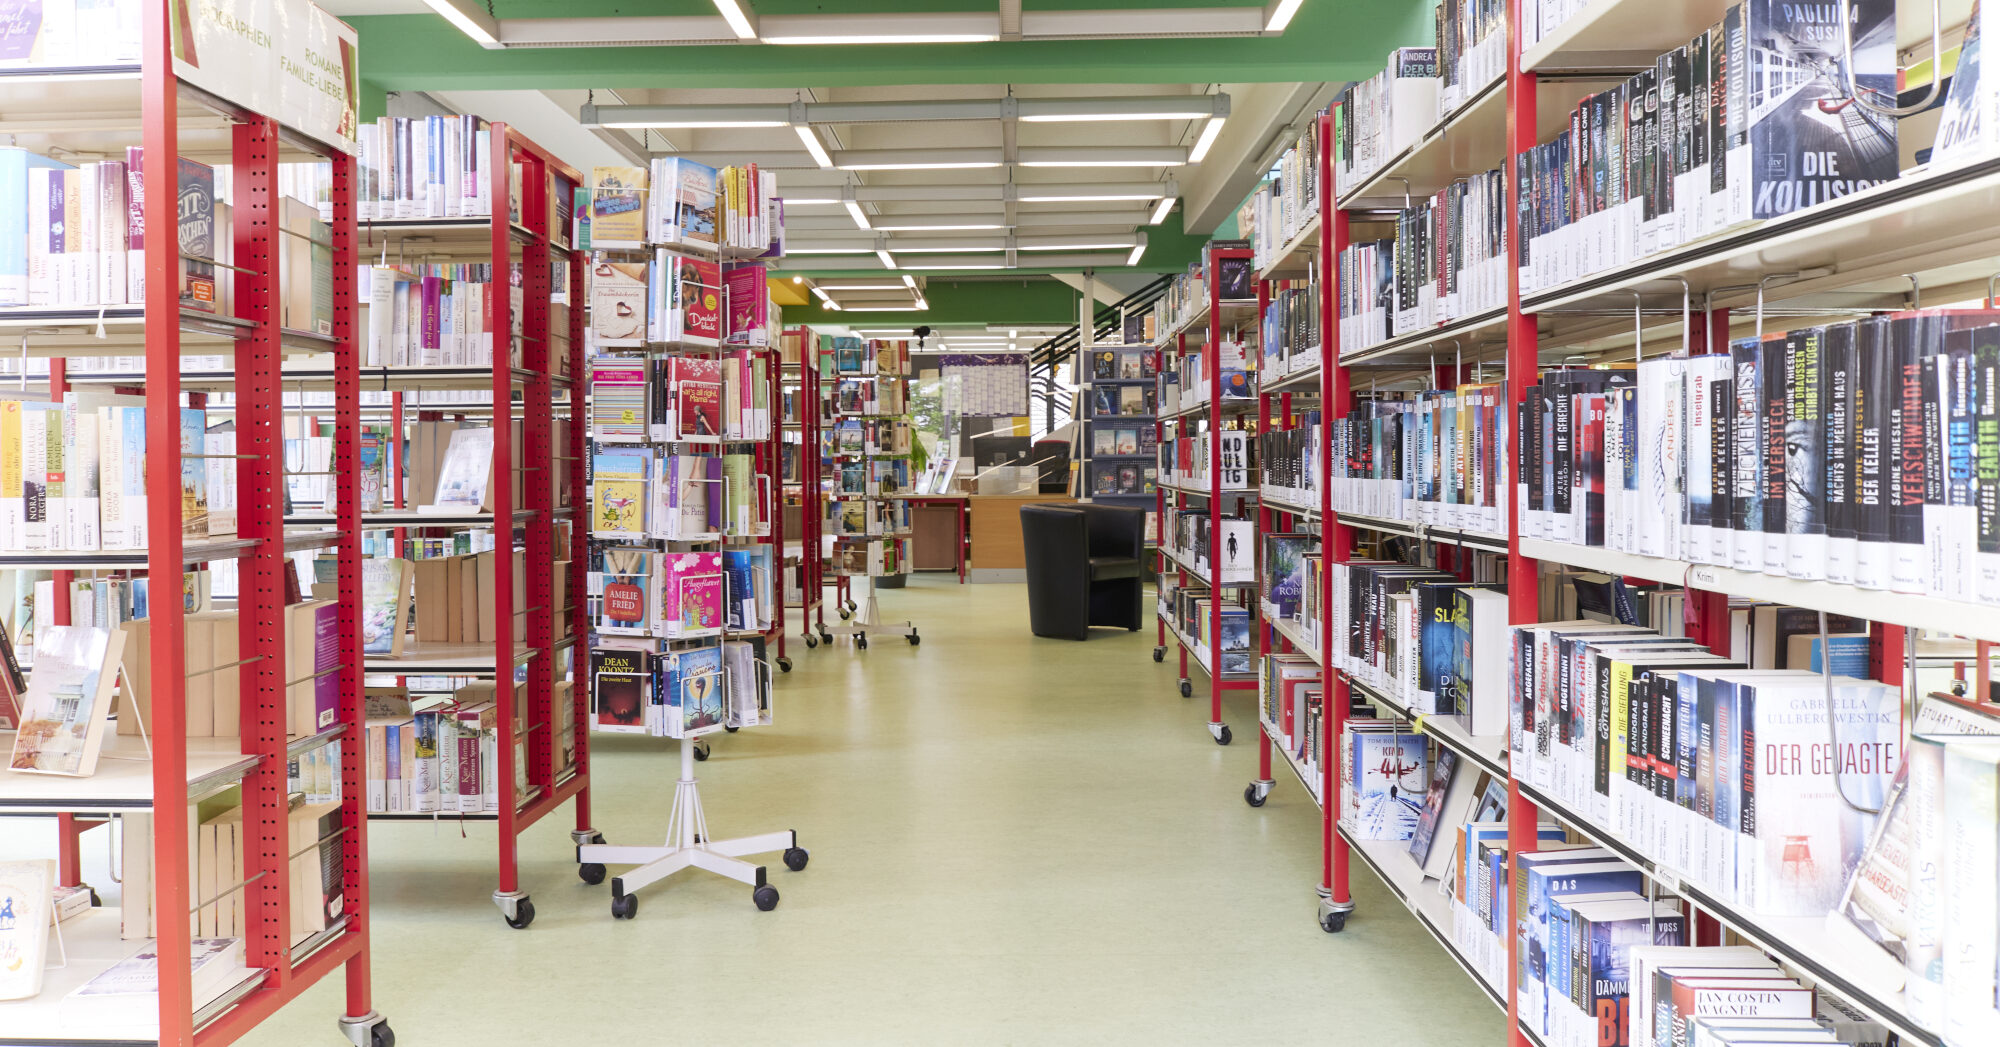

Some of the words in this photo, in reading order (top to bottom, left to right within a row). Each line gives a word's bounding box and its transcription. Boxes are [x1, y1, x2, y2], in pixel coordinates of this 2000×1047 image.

[200, 5, 271, 49] OGRAPHIEN
[1782, 3, 1859, 24] PAULIIA
[1806, 26, 1839, 41] SUSI
[305, 48, 342, 81] ROMANE
[1404, 52, 1433, 61] ANDREA
[1404, 65, 1424, 73] DER
[1731, 28, 1744, 98] KOLLISION
[281, 56, 343, 101] FAMILIE-LIEBE
[1711, 81, 1720, 106] DAS
[1731, 100, 1743, 124] DIE
[1802, 151, 1840, 177] DIE
[1595, 170, 1604, 192] Die
[1753, 179, 1889, 216] KOLLISI
[1787, 342, 1795, 384] THIESLER
[1806, 335, 1818, 366] VOGEL
[1795, 350, 1805, 399] DRAUSSEN
[1806, 369, 1818, 384] EIN
[1834, 370, 1846, 398] HAUS
[1557, 393, 1568, 433] GERECHTE
[1694, 376, 1704, 427] Inselgrab
[1787, 387, 1795, 421] SABINE
[1795, 401, 1805, 420] UND
[1806, 387, 1818, 420] STIRBT
[1533, 393, 1541, 465] KASTANIENMANN
[1738, 362, 1757, 497] ZECKENBISS
[1770, 397, 1784, 474] VERSTECK
[1834, 402, 1845, 443] MEINEM
[1855, 389, 1863, 449] THIESLER
[1891, 409, 1901, 460] THIESLER
[1902, 363, 1924, 506] VERSCHWUNDEN
[1557, 436, 1568, 452] DIE
[1717, 417, 1726, 463] KELLER
[1834, 447, 1845, 459] IN
[1863, 427, 1879, 474] KELLER
[1949, 422, 1969, 479] EARTH
[1978, 420, 1998, 479] EARTH
[1717, 470, 1726, 494] DER
[1771, 482, 1784, 499] IM
[1834, 462, 1845, 503] NACHTS
[1855, 457, 1863, 505] SABINE
[1863, 479, 1879, 505] DER
[1891, 466, 1901, 506] SABINE
[28, 495, 37, 519] NORA
[1696, 570, 1714, 583] Krimi
[610, 590, 638, 601] AMELIE
[612, 600, 635, 610] FRIED
[1378, 583, 1386, 630] Verstummt
[604, 657, 629, 667] DEAN
[1524, 643, 1532, 700] ABGEFACKELT
[1538, 641, 1548, 713] Zerbrochen
[1552, 645, 1560, 713] Zerrissen
[1560, 654, 1568, 712] ABGETRENNT
[1619, 670, 1627, 715] SIEDLUNG
[1600, 667, 1609, 740] GOTTESHAUS
[1790, 698, 1868, 710] GABRELLA
[1833, 712, 1891, 724] WESTIN
[1921, 707, 1954, 726] STUART
[1661, 695, 1671, 760] SCHNEENACHT
[1680, 687, 1690, 758] SCHMETTERLING
[459, 740, 469, 768] Morton
[1700, 723, 1710, 758] LÄUFER
[1744, 729, 1754, 771] GEJAGTE
[461, 767, 470, 783] Kate
[1680, 759, 1690, 777] DER
[1701, 760, 1710, 778] DER
[1766, 743, 1801, 775] DER
[1810, 742, 1894, 775] GEJAGTE
[1744, 775, 1754, 793] DER
[1552, 880, 1577, 891] DAS
[1864, 865, 1908, 909] HARDCASTL
[1919, 861, 1936, 948] VARGAS
[1658, 922, 1678, 932] VOSS
[1699, 991, 1721, 1003] JAN
[1723, 991, 1781, 1004] COSTIN
[1699, 1003, 1758, 1016] WAGNER
